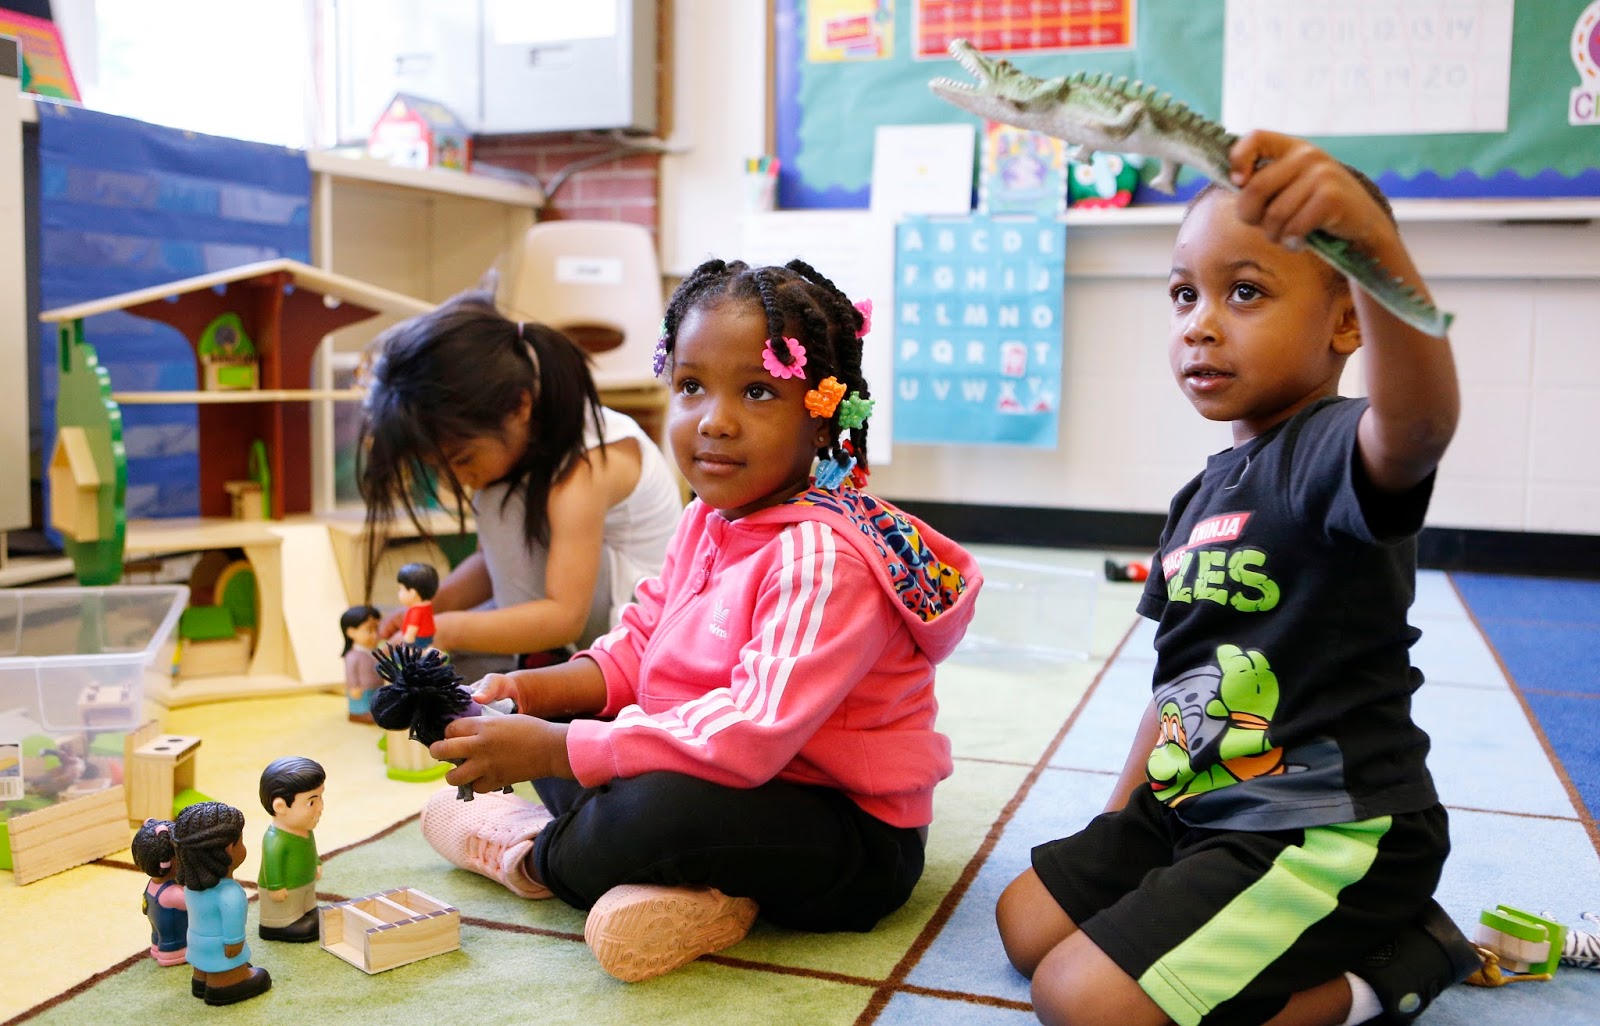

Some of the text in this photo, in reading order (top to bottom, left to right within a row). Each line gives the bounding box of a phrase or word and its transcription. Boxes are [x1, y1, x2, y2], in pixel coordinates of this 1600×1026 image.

[1445, 16, 1475, 41] 14
[1423, 63, 1468, 89] 20
[904, 229, 1054, 252] A B C D E
[904, 265, 920, 287] F
[966, 268, 987, 290] H
[1004, 269, 1015, 290] I
[1035, 269, 1050, 292] J
[901, 302, 1053, 329] K L M N O
[901, 339, 1051, 365] P Q R T
[900, 378, 919, 401] U
[932, 379, 951, 401] V
[962, 379, 988, 402] W
[1198, 517, 1241, 542] NINJA
